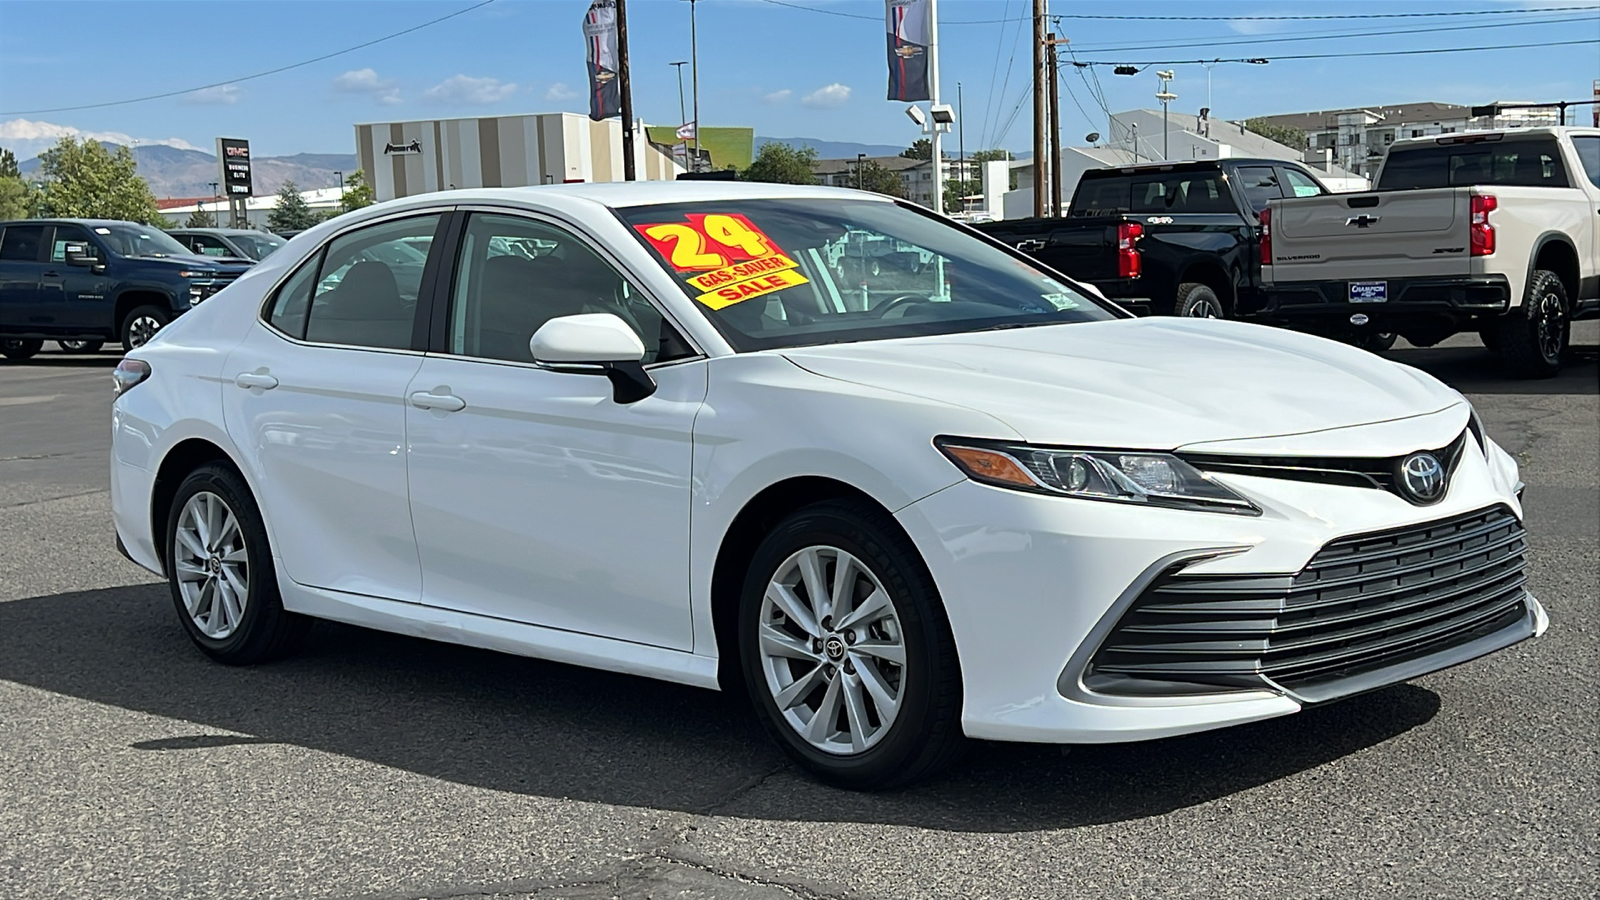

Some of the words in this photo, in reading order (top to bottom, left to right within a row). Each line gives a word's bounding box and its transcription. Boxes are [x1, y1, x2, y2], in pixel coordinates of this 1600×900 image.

[227, 147, 248, 156] GMC
[645, 214, 774, 269] 24
[717, 275, 789, 302] SALE
